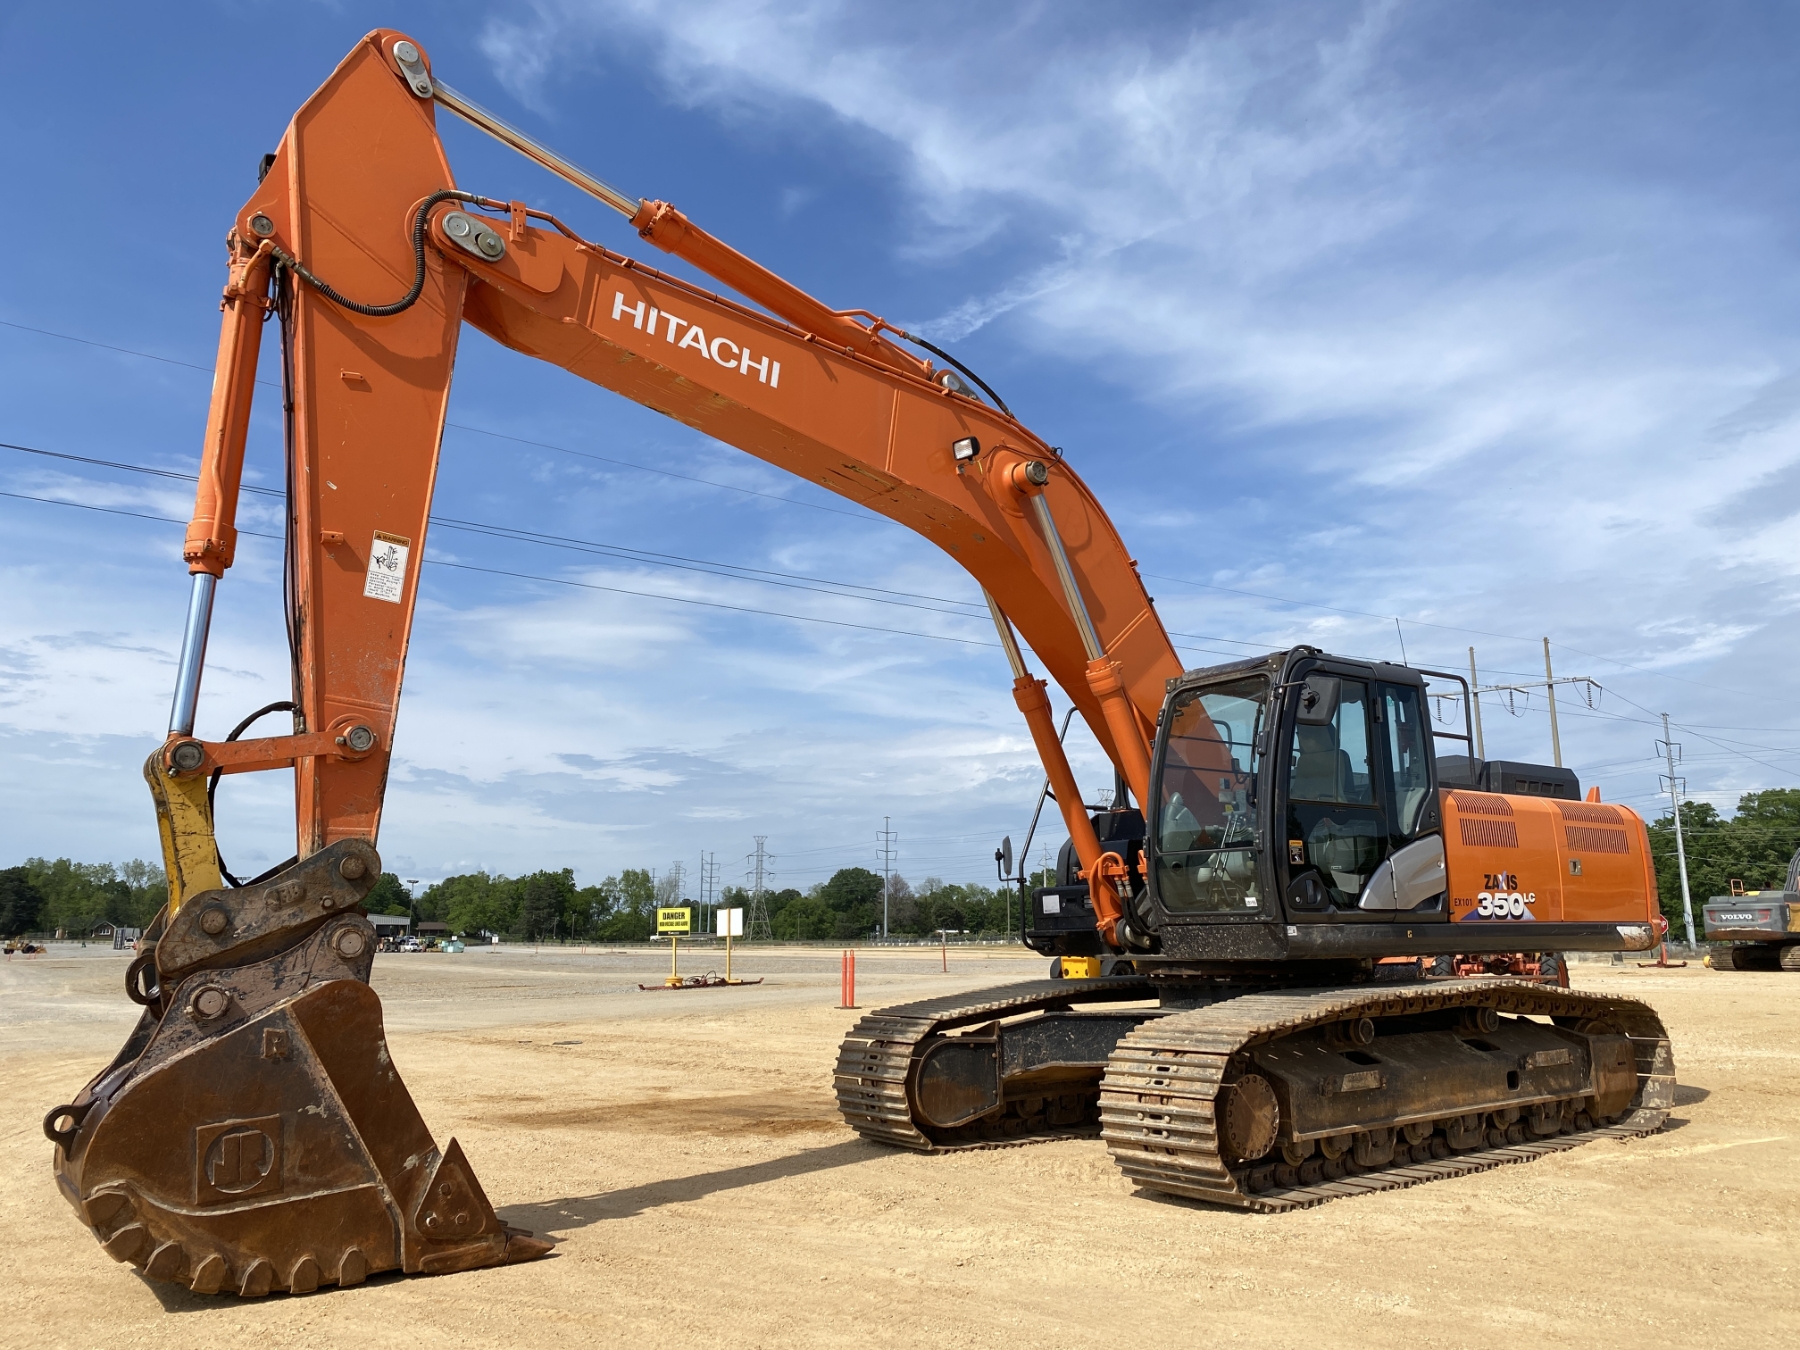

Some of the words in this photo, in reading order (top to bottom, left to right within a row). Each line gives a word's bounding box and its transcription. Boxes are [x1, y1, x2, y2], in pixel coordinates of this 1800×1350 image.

[612, 291, 781, 389] HITACHI
[1484, 870, 1518, 891] ZAXIS
[1454, 898, 1473, 907] EX101
[662, 912, 686, 920] DANGER
